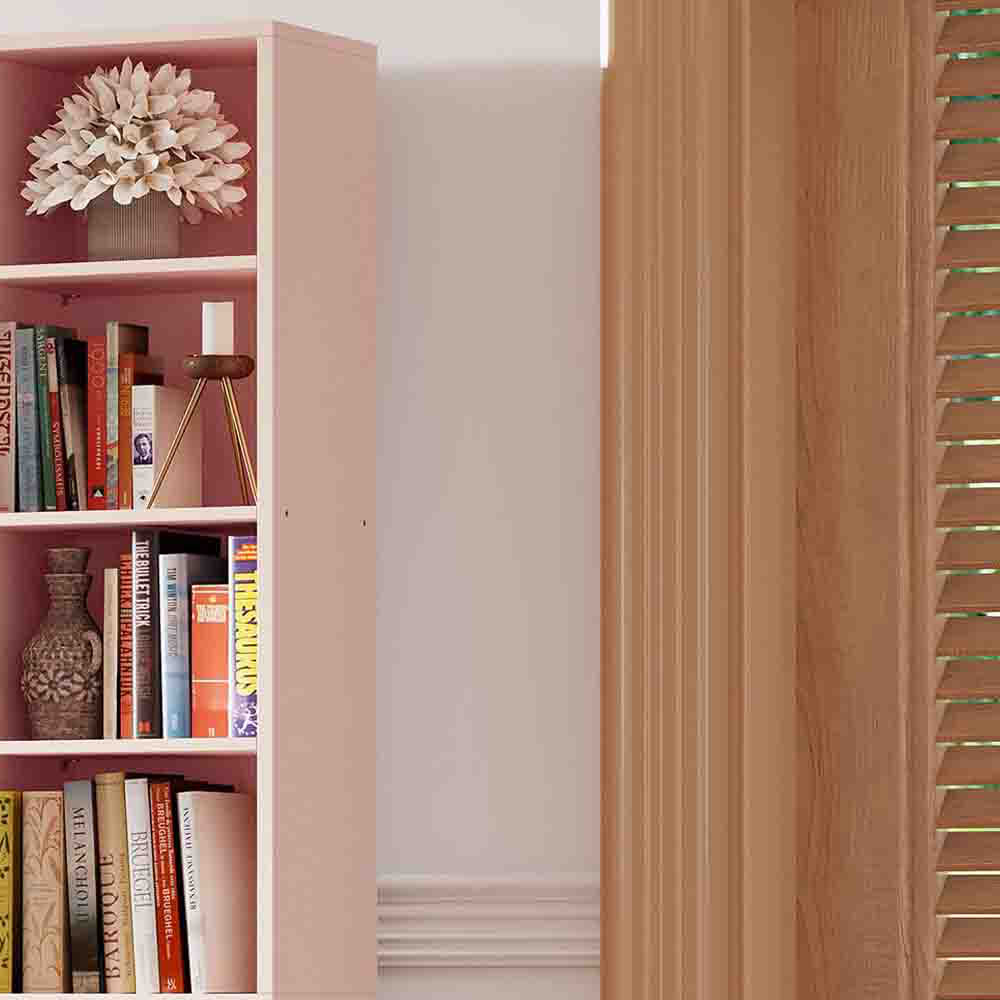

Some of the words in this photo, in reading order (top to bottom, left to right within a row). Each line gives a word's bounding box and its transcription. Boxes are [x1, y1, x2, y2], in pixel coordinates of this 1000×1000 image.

[135, 540, 150, 558] THE
[167, 568, 177, 581] TIM
[135, 560, 151, 595] BULLET
[136, 598, 151, 627] TRICK
[234, 569, 258, 697] THESAURUS
[157, 803, 168, 855] BREUGHEL
[131, 831, 154, 912] BRUEGEL
[98, 853, 121, 980] BAROQUE
[162, 888, 173, 940] BRUEGHEL
